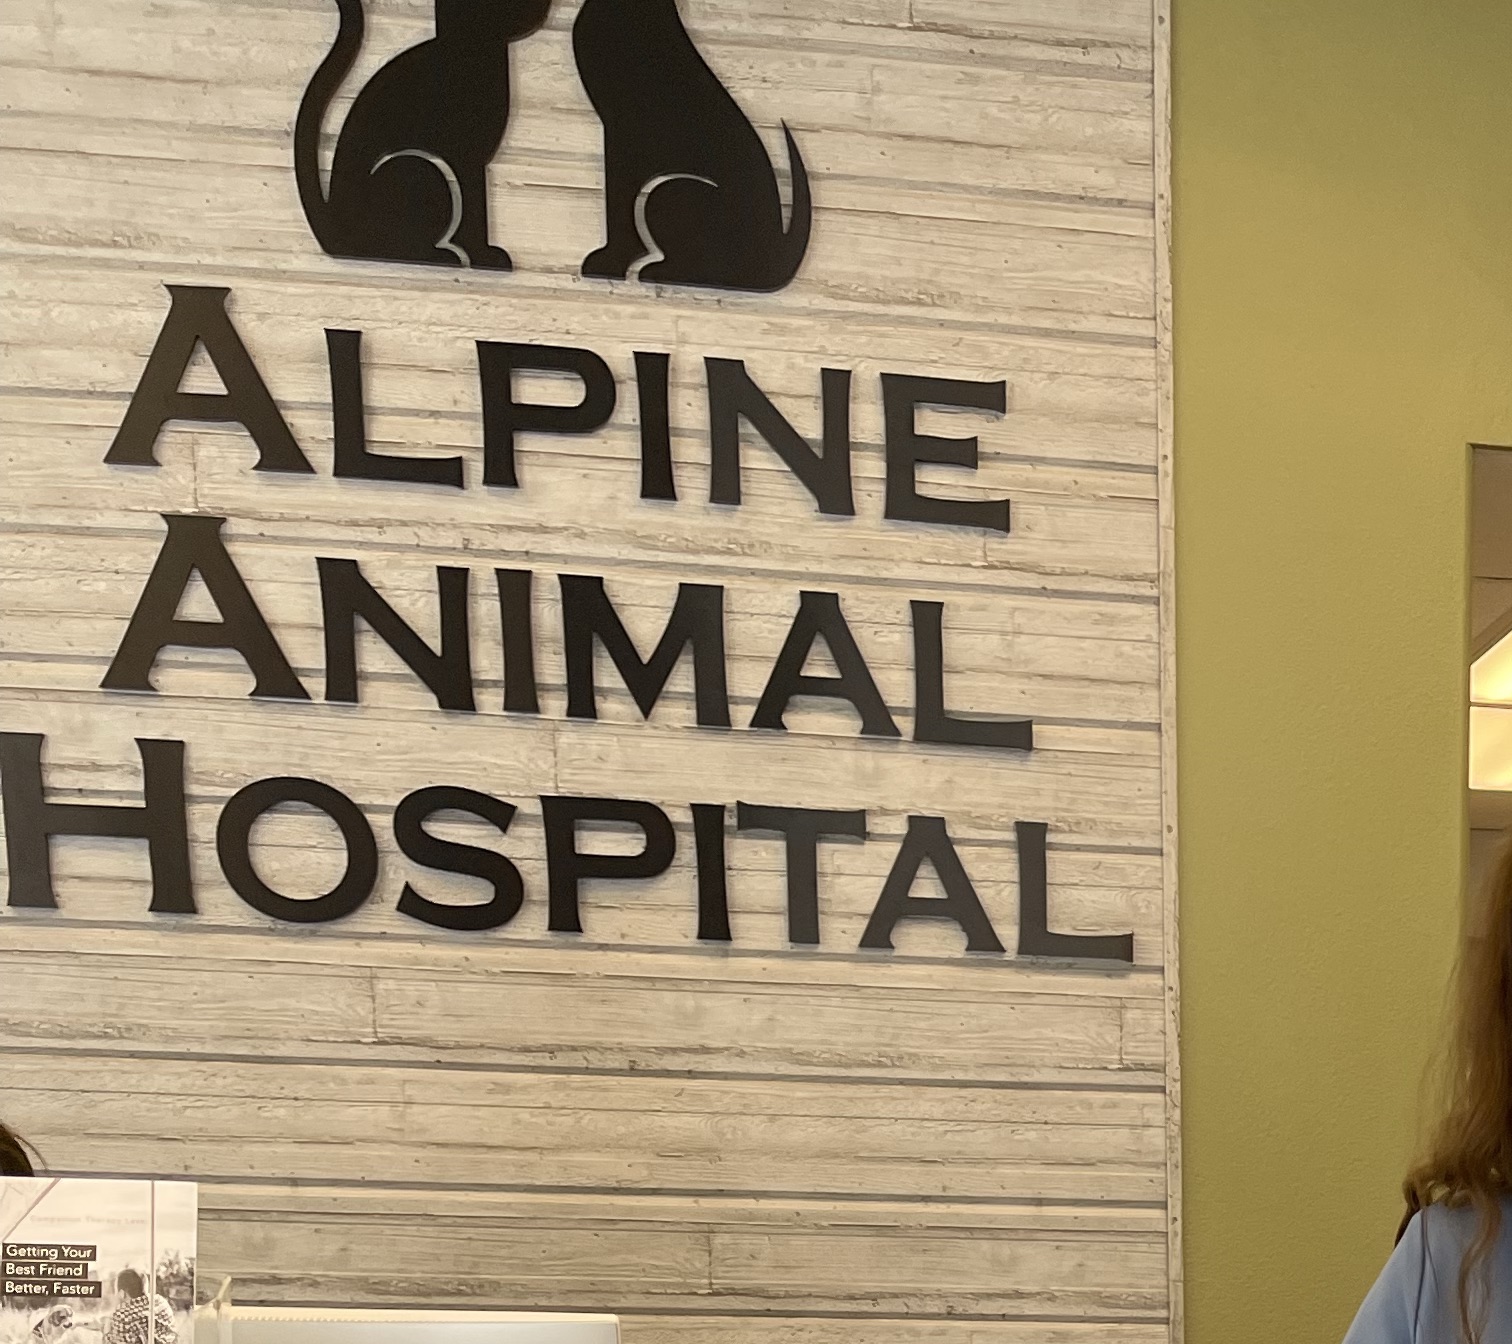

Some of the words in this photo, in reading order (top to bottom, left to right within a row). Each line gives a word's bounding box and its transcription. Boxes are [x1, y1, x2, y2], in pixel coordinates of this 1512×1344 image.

[103, 283, 1012, 535] ALPINE
[99, 512, 1034, 753] ANIMAL
[0, 731, 1135, 965] HOSPITAL
[5, 1262, 36, 1276] Best
[39, 1263, 84, 1277] Friend
[5, 1280, 49, 1296] Better,
[53, 1281, 96, 1296] Faster
[6, 1244, 59, 1261] Getting
[61, 1245, 93, 1259] Your
